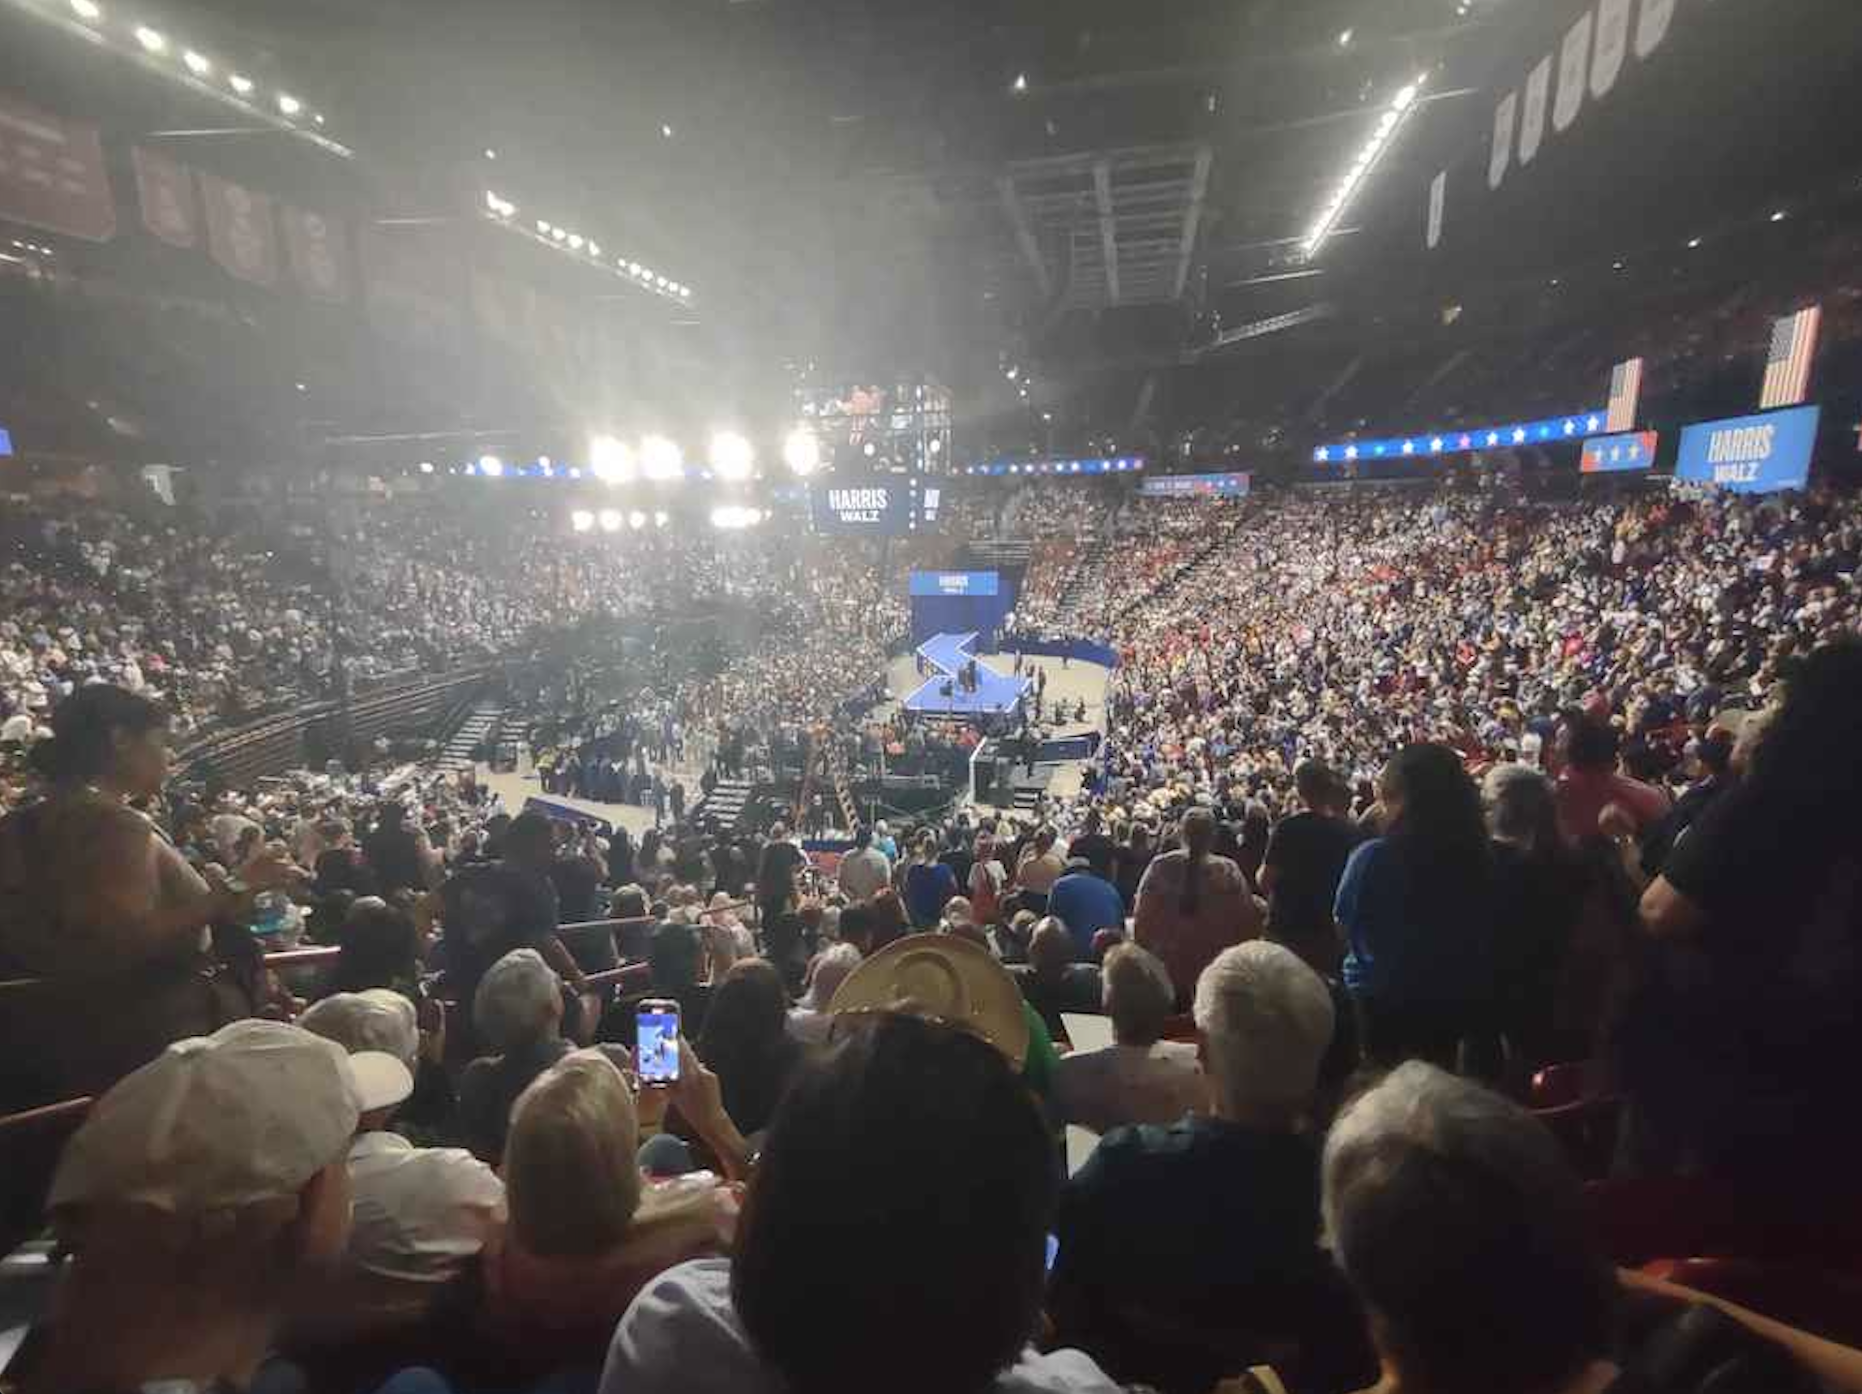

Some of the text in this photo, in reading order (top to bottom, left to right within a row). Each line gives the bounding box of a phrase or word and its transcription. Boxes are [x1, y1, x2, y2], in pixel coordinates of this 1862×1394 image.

[1709, 424, 1775, 462] HARRIS
[1715, 462, 1759, 482] WALZ
[828, 489, 888, 509] HARRIS
[840, 510, 880, 522] WALZ
